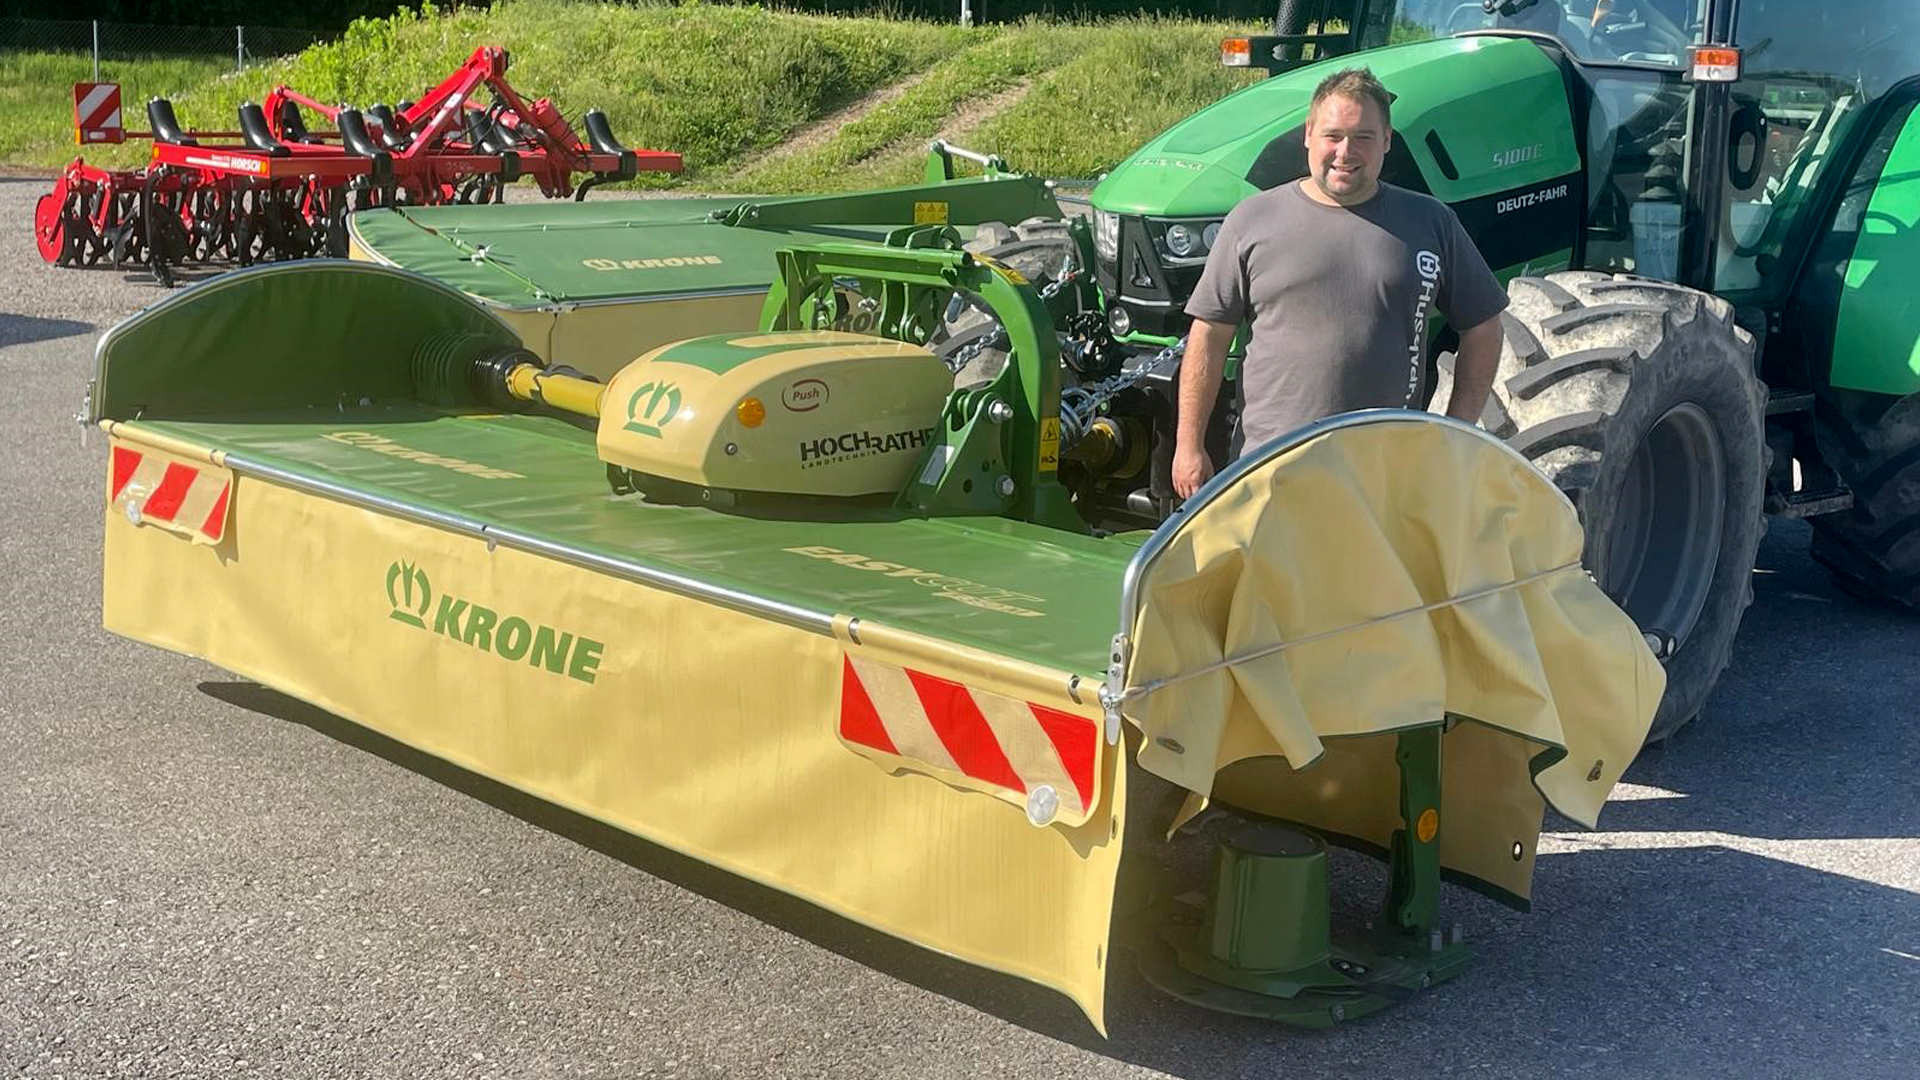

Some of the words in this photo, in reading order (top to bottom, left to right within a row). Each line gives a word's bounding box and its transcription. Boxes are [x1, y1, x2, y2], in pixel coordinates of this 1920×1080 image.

[1497, 184, 1568, 214] DEUTZ-FAHR
[621, 255, 723, 270] KRONE
[792, 387, 820, 401] Push
[801, 450, 878, 470] LANDTECHNIK
[434, 594, 604, 684] KRONE
